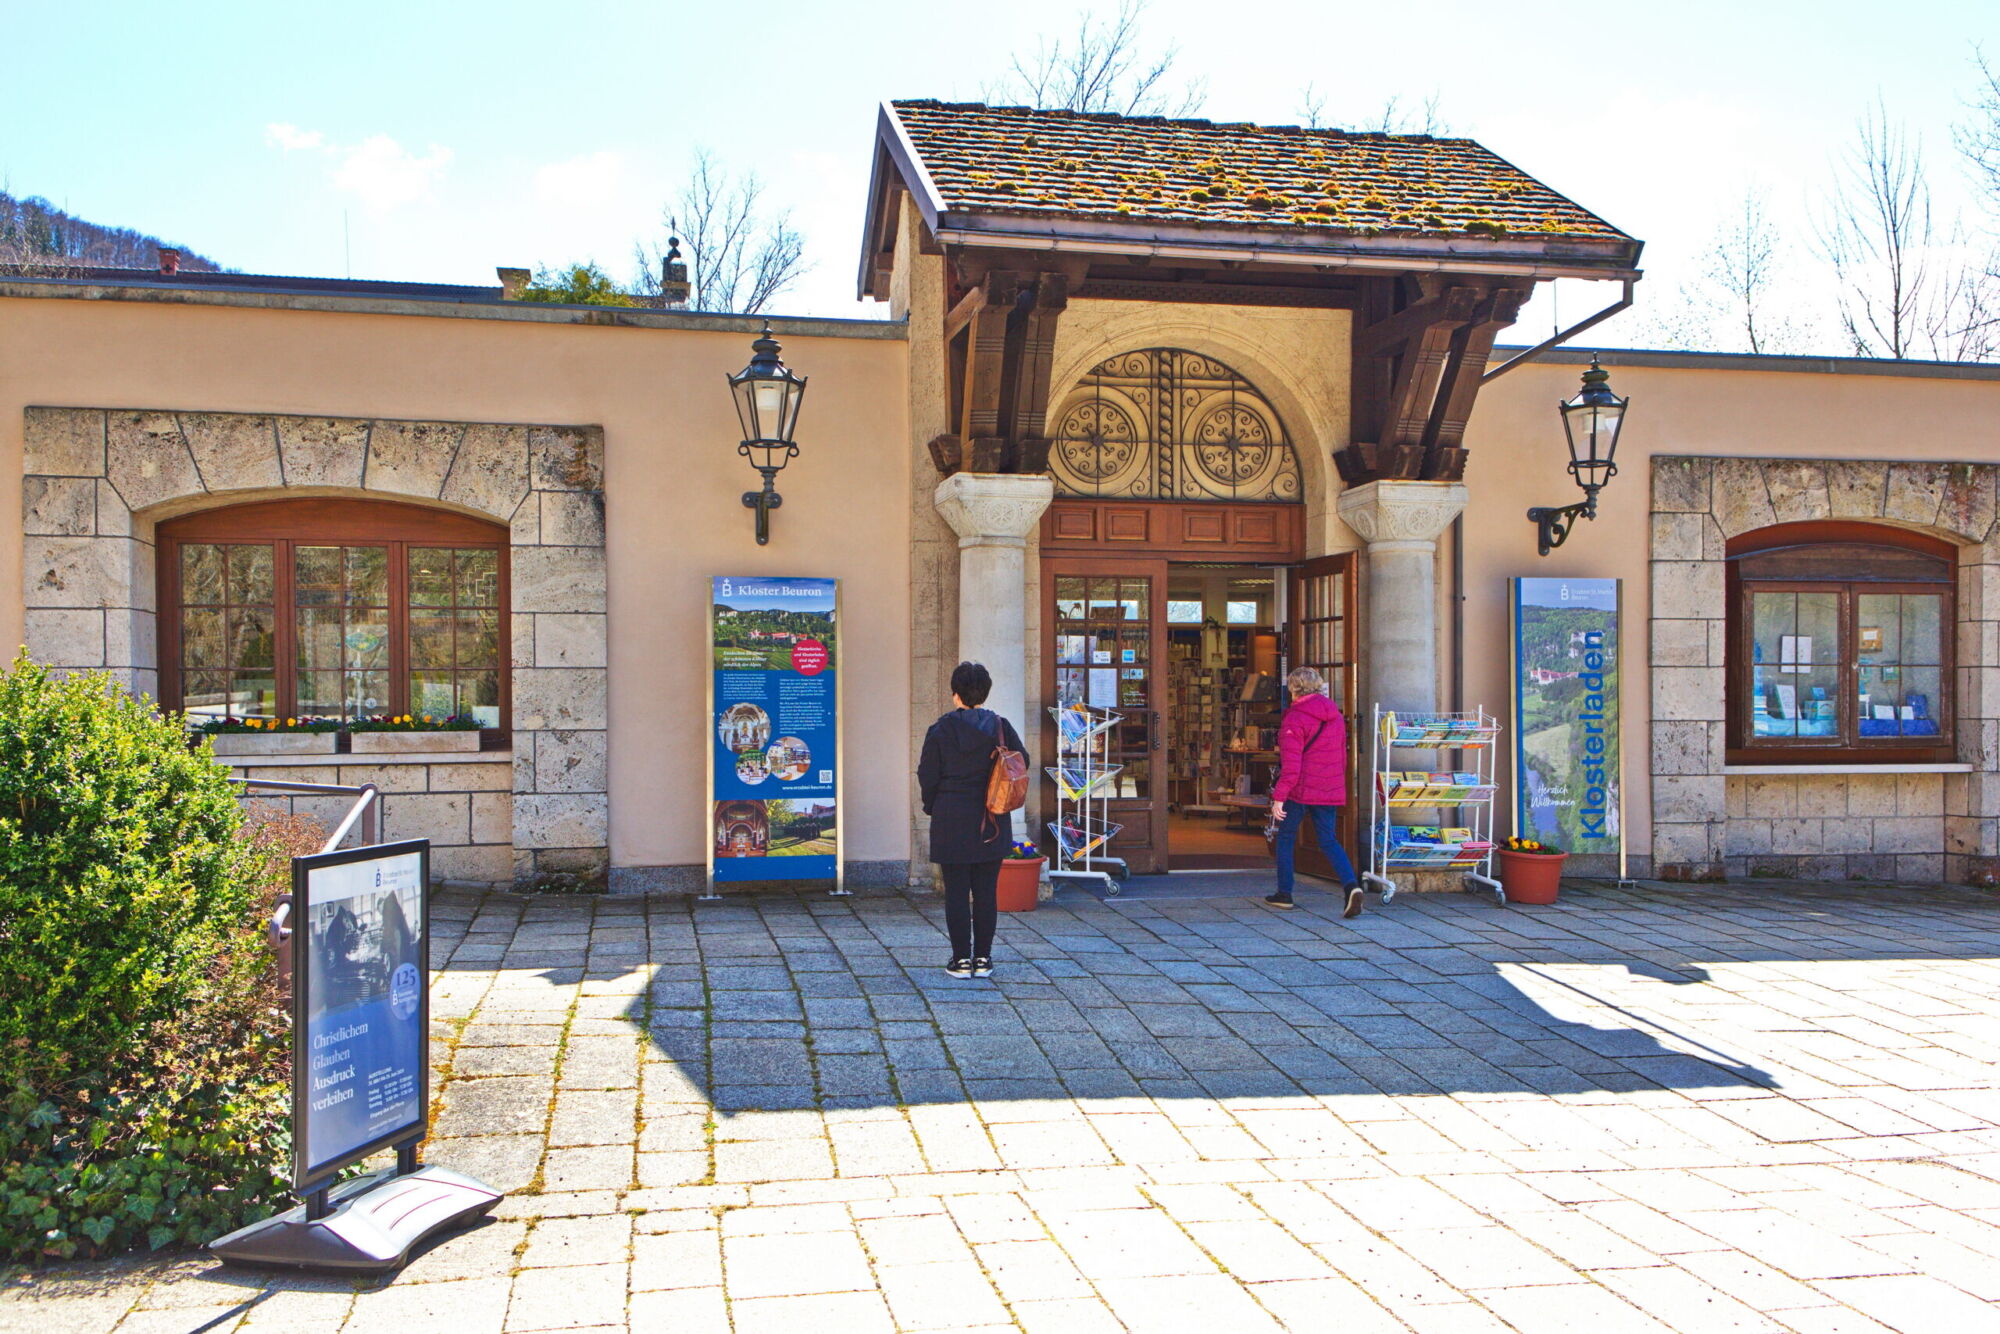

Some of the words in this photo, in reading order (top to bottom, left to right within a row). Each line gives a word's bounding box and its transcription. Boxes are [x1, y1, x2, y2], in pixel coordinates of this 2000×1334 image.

[738, 585, 779, 596] Kloster
[782, 586, 822, 596] Beuron
[1578, 631, 1606, 838] Klosterladen
[1538, 783, 1569, 796] Herzlich
[1530, 797, 1576, 808] Willkommen
[397, 968, 416, 986] 125
[313, 1023, 368, 1050] Christlichem
[312, 1048, 351, 1070] Glauben
[312, 1064, 356, 1091] Ausdruck
[312, 1088, 354, 1112] verleihen
